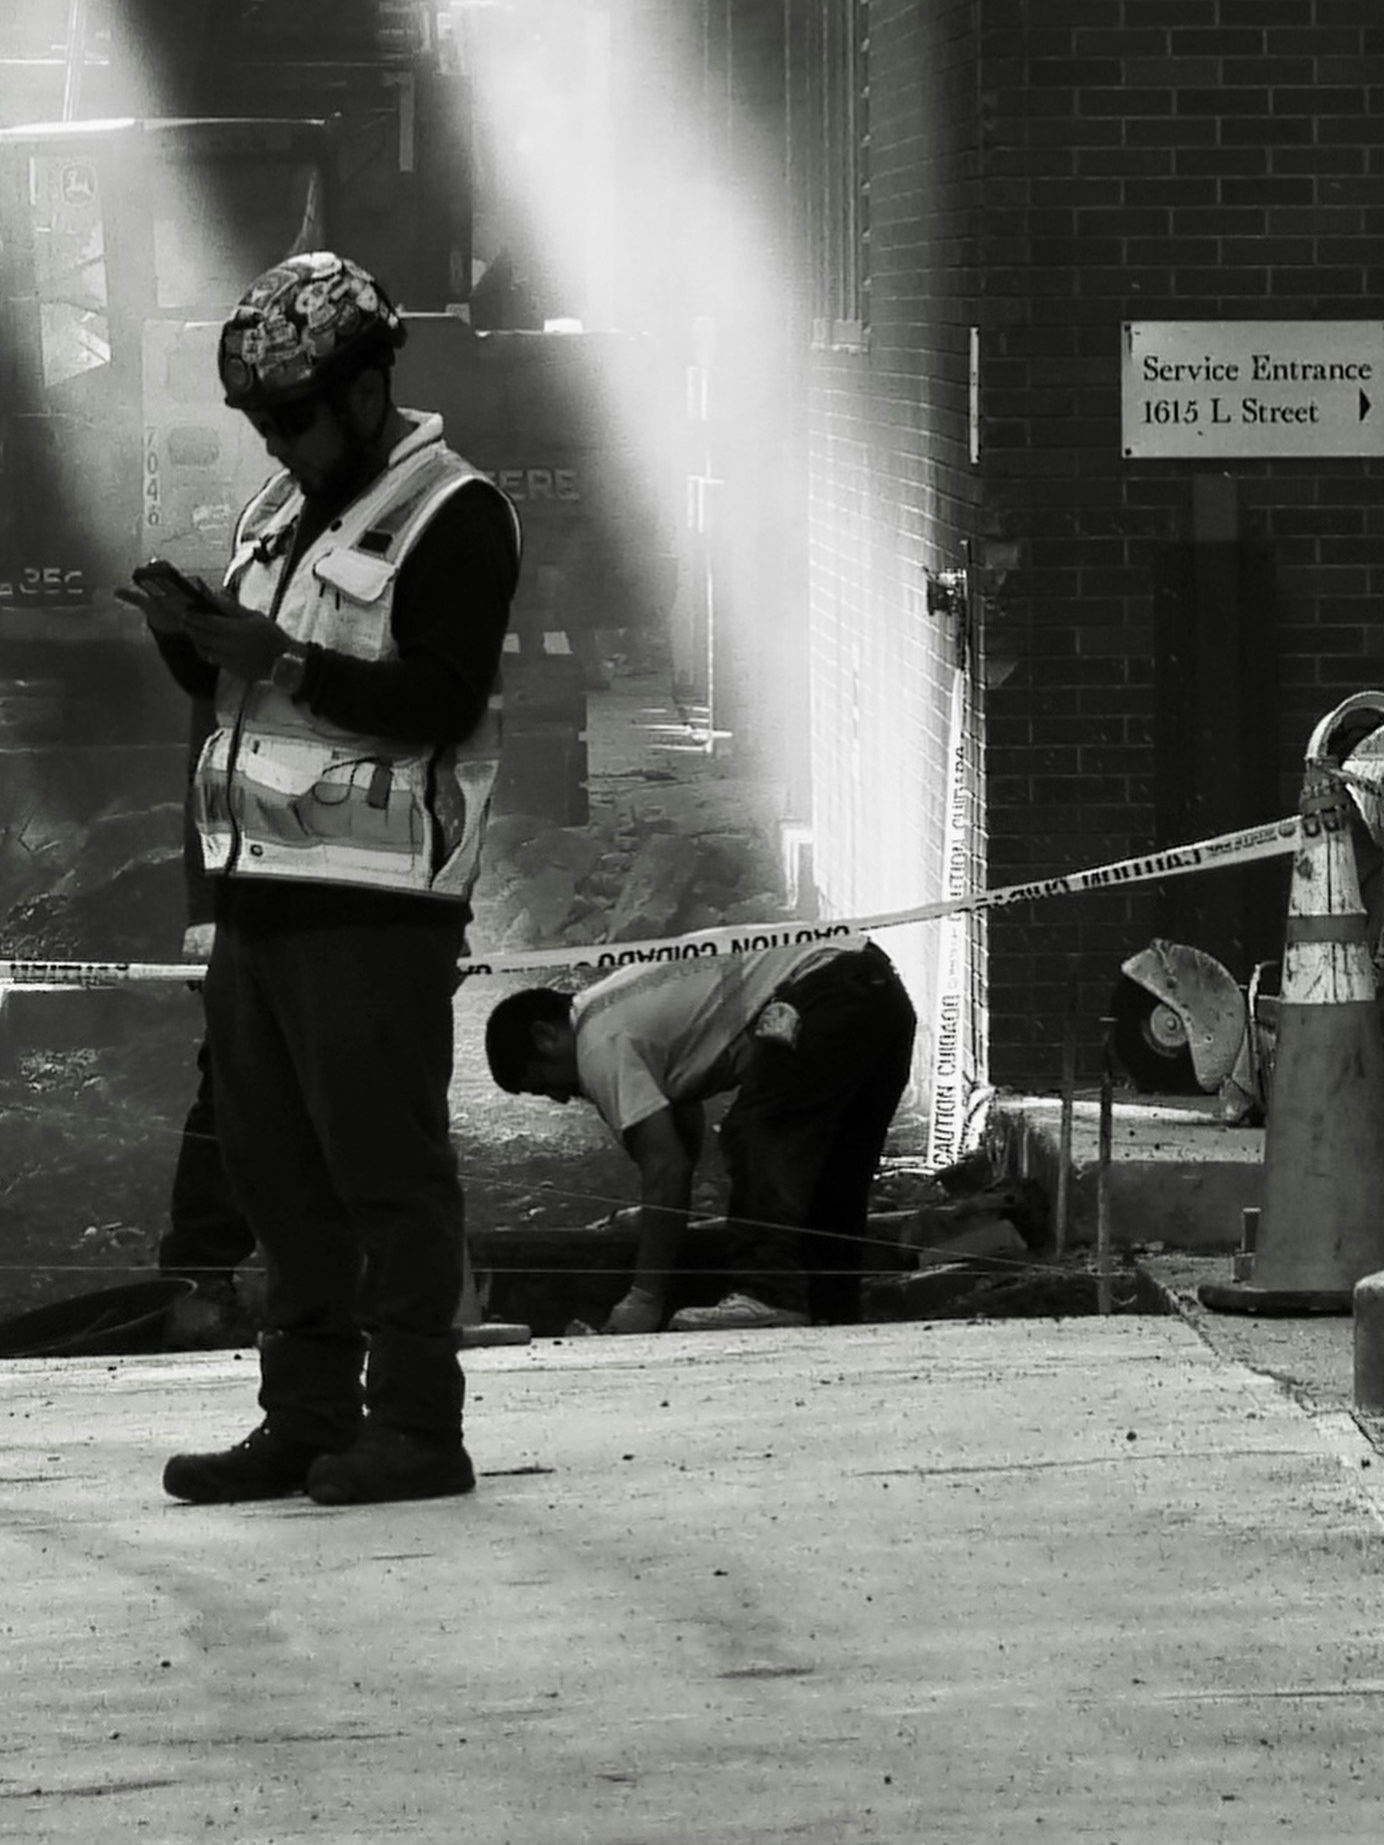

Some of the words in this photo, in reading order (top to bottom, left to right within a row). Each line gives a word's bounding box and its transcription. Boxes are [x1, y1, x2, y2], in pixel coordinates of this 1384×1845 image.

[1144, 356, 1238, 381] Service
[1252, 355, 1372, 381] Entrance
[1145, 400, 1198, 423] 1615
[1211, 398, 1231, 423] L
[1242, 398, 1318, 423] Street
[933, 1085, 956, 1166] CAUTION
